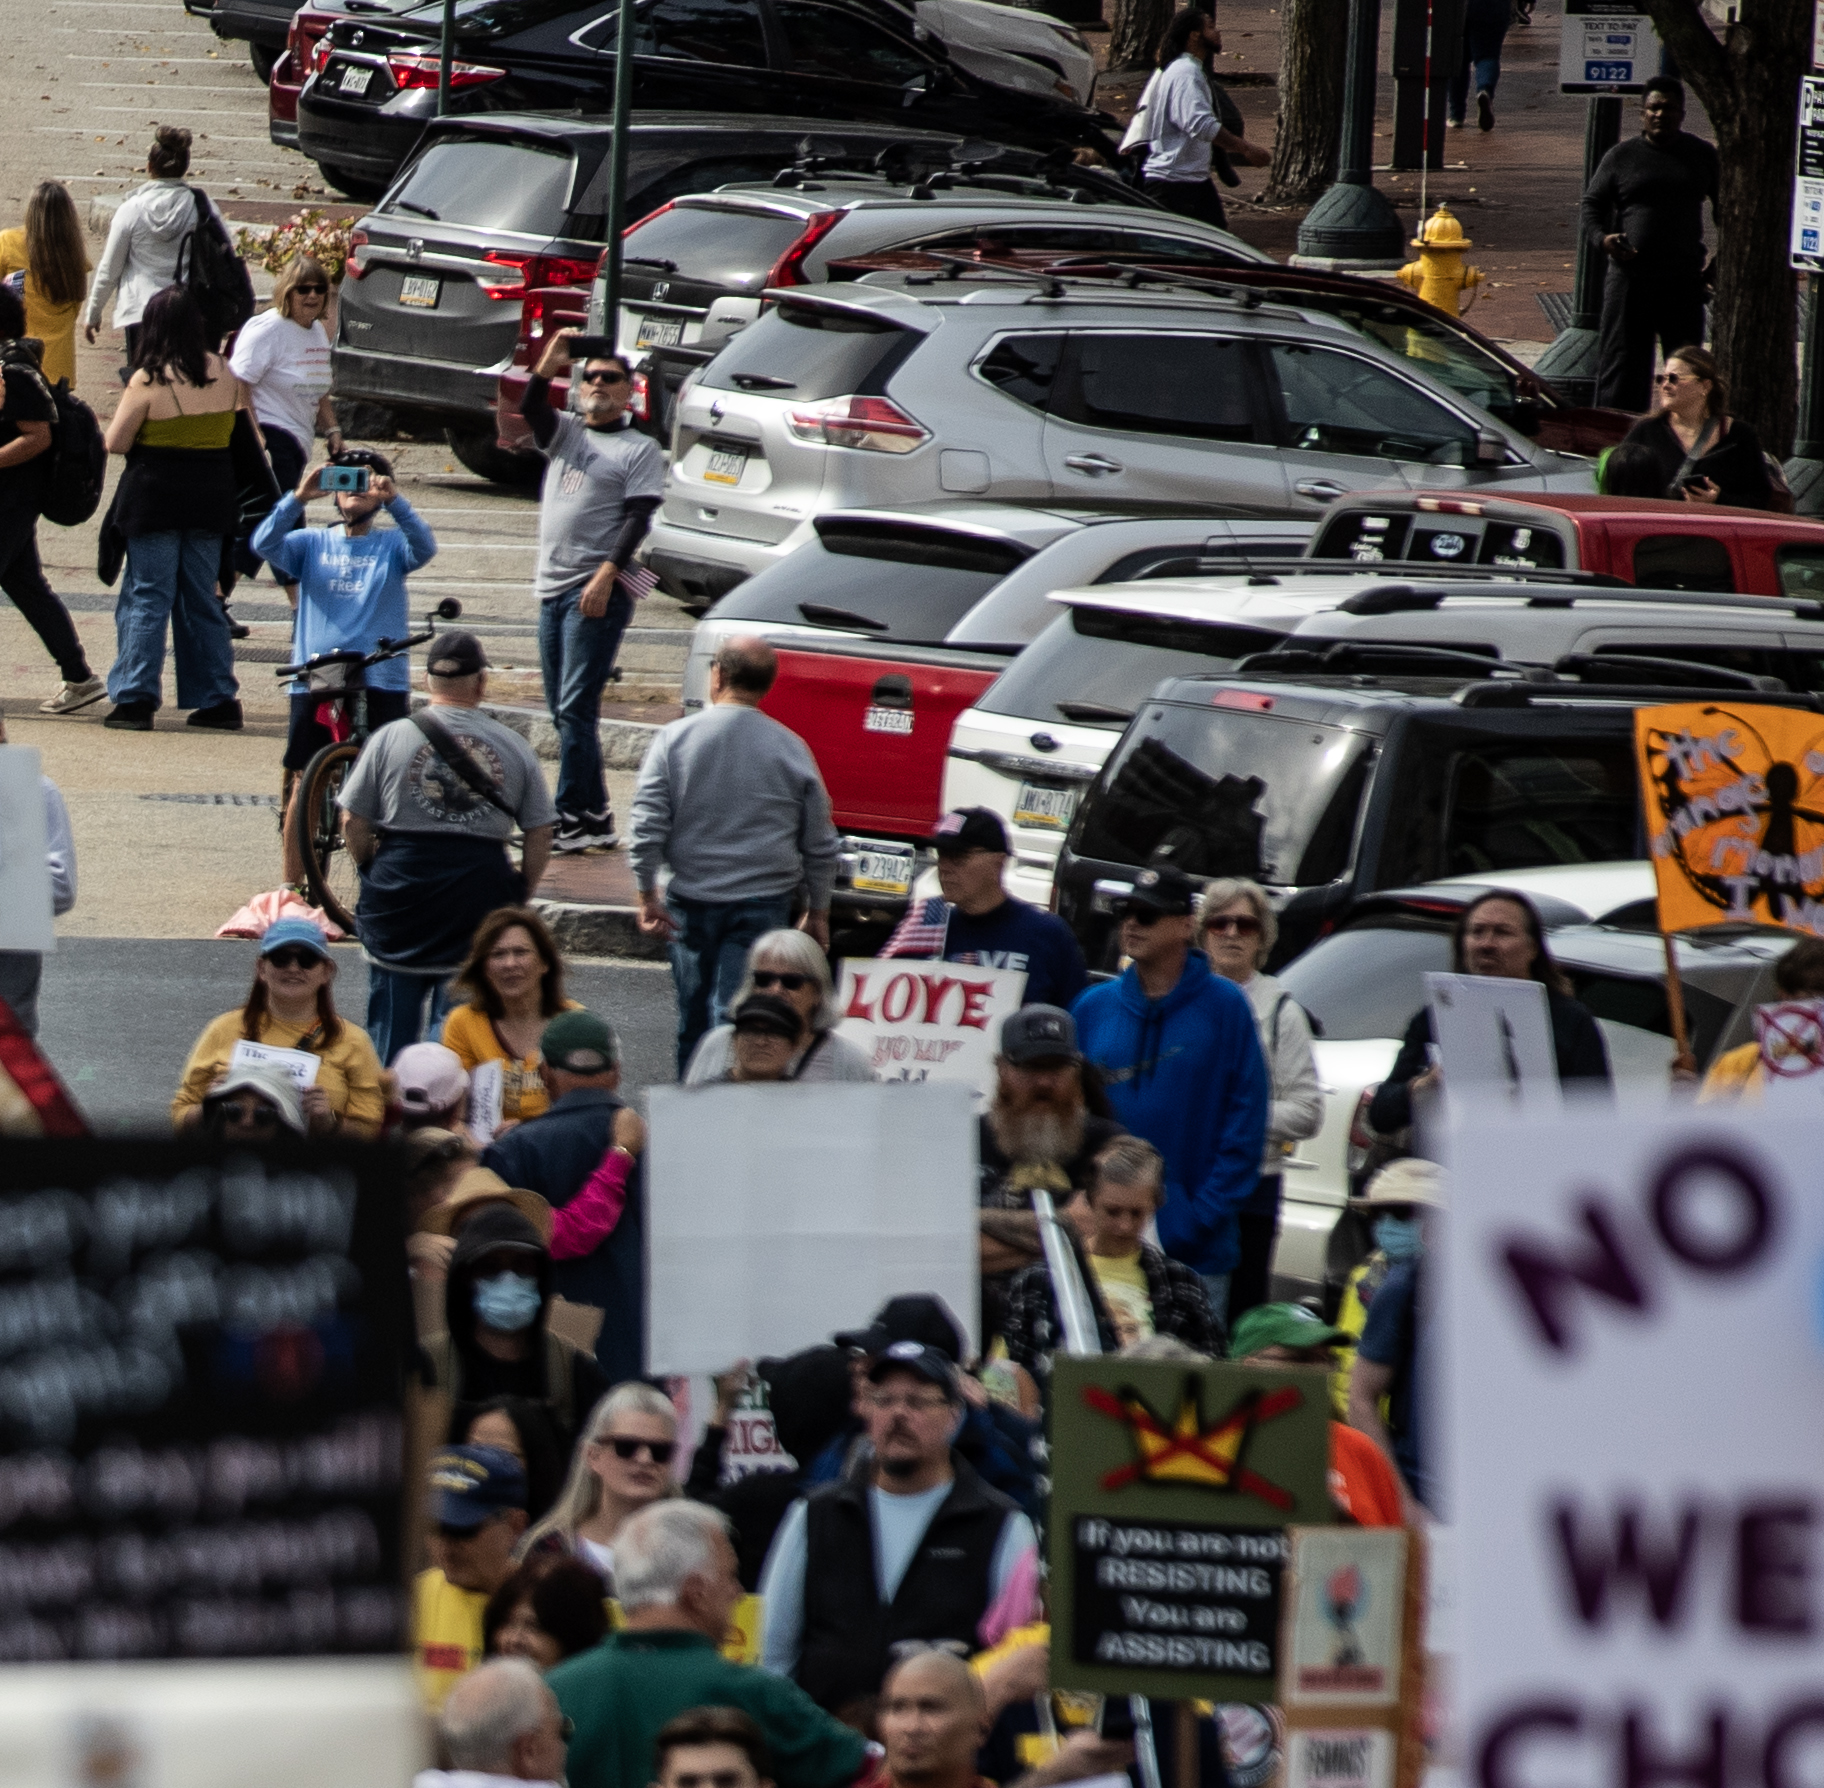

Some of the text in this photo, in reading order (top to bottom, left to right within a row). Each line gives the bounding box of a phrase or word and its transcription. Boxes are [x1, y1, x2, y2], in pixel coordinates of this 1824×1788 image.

[1590, 67, 1627, 80] 9122
[320, 551, 376, 568] KINDNESS
[1492, 1133, 1784, 1357] NO
[1079, 1518, 1291, 1562] If you are not
[1098, 1554, 1273, 1598] RESISTING
[1550, 1496, 1816, 1638] WE
[1120, 1593, 1248, 1633] You are
[1097, 1630, 1272, 1672] ASSISTING
